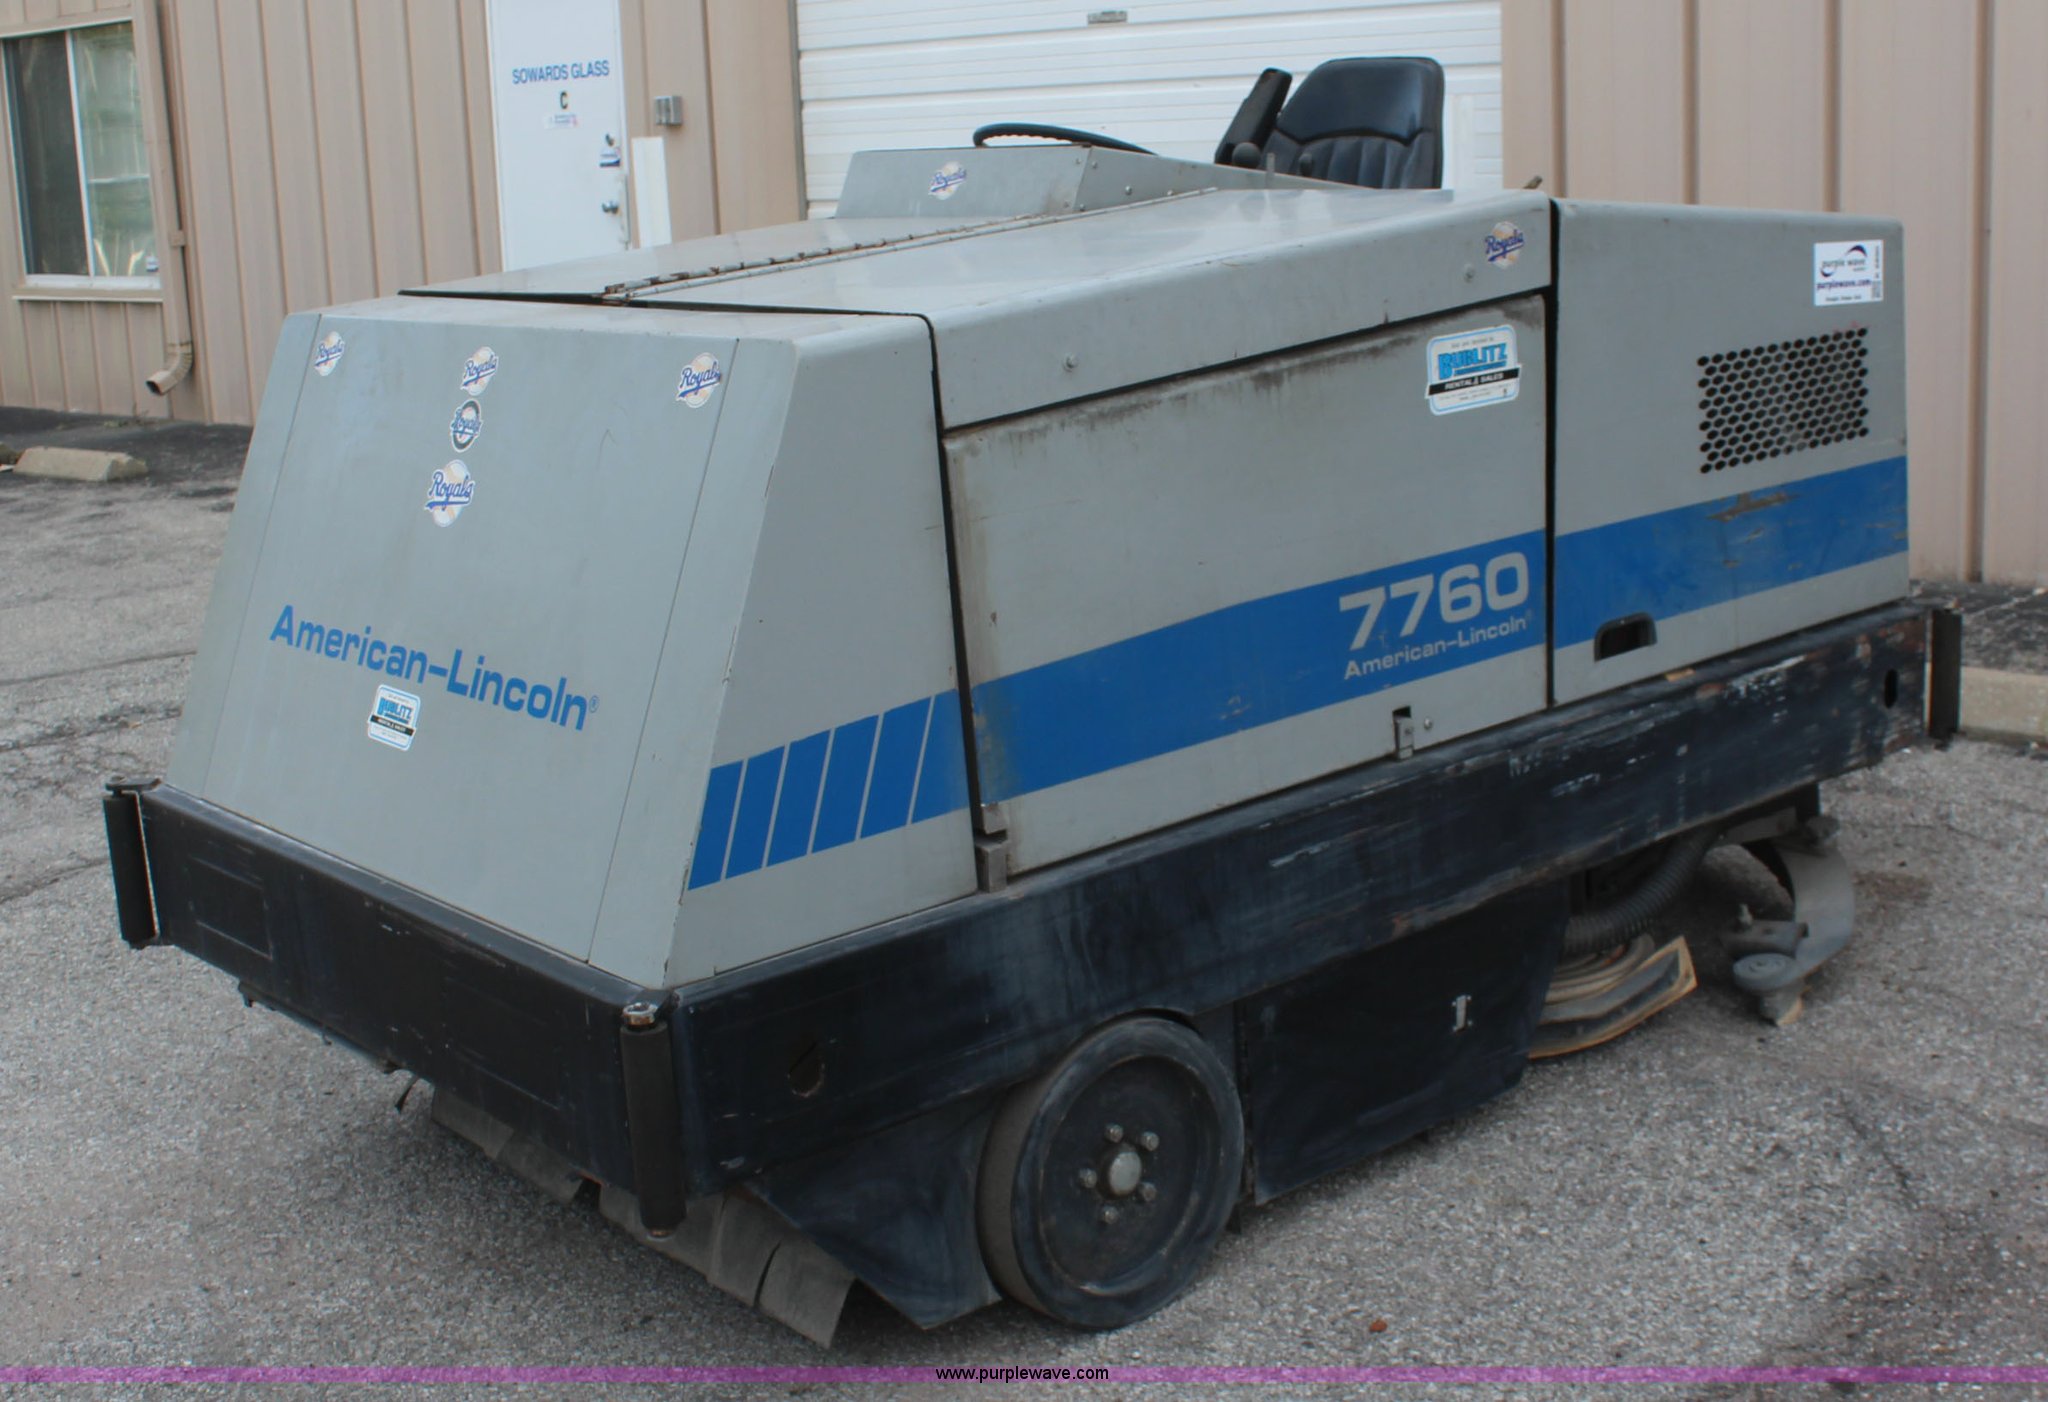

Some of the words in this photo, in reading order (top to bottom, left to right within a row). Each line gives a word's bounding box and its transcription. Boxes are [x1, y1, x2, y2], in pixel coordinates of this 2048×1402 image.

[512, 63, 569, 85] SOWARDS
[570, 59, 609, 79] GLASS
[560, 90, 569, 110] C
[1485, 230, 1524, 261] Royals
[462, 355, 498, 386] Royals
[679, 361, 722, 397] Royals
[425, 471, 474, 511] Royals
[1339, 551, 1529, 651] 7760
